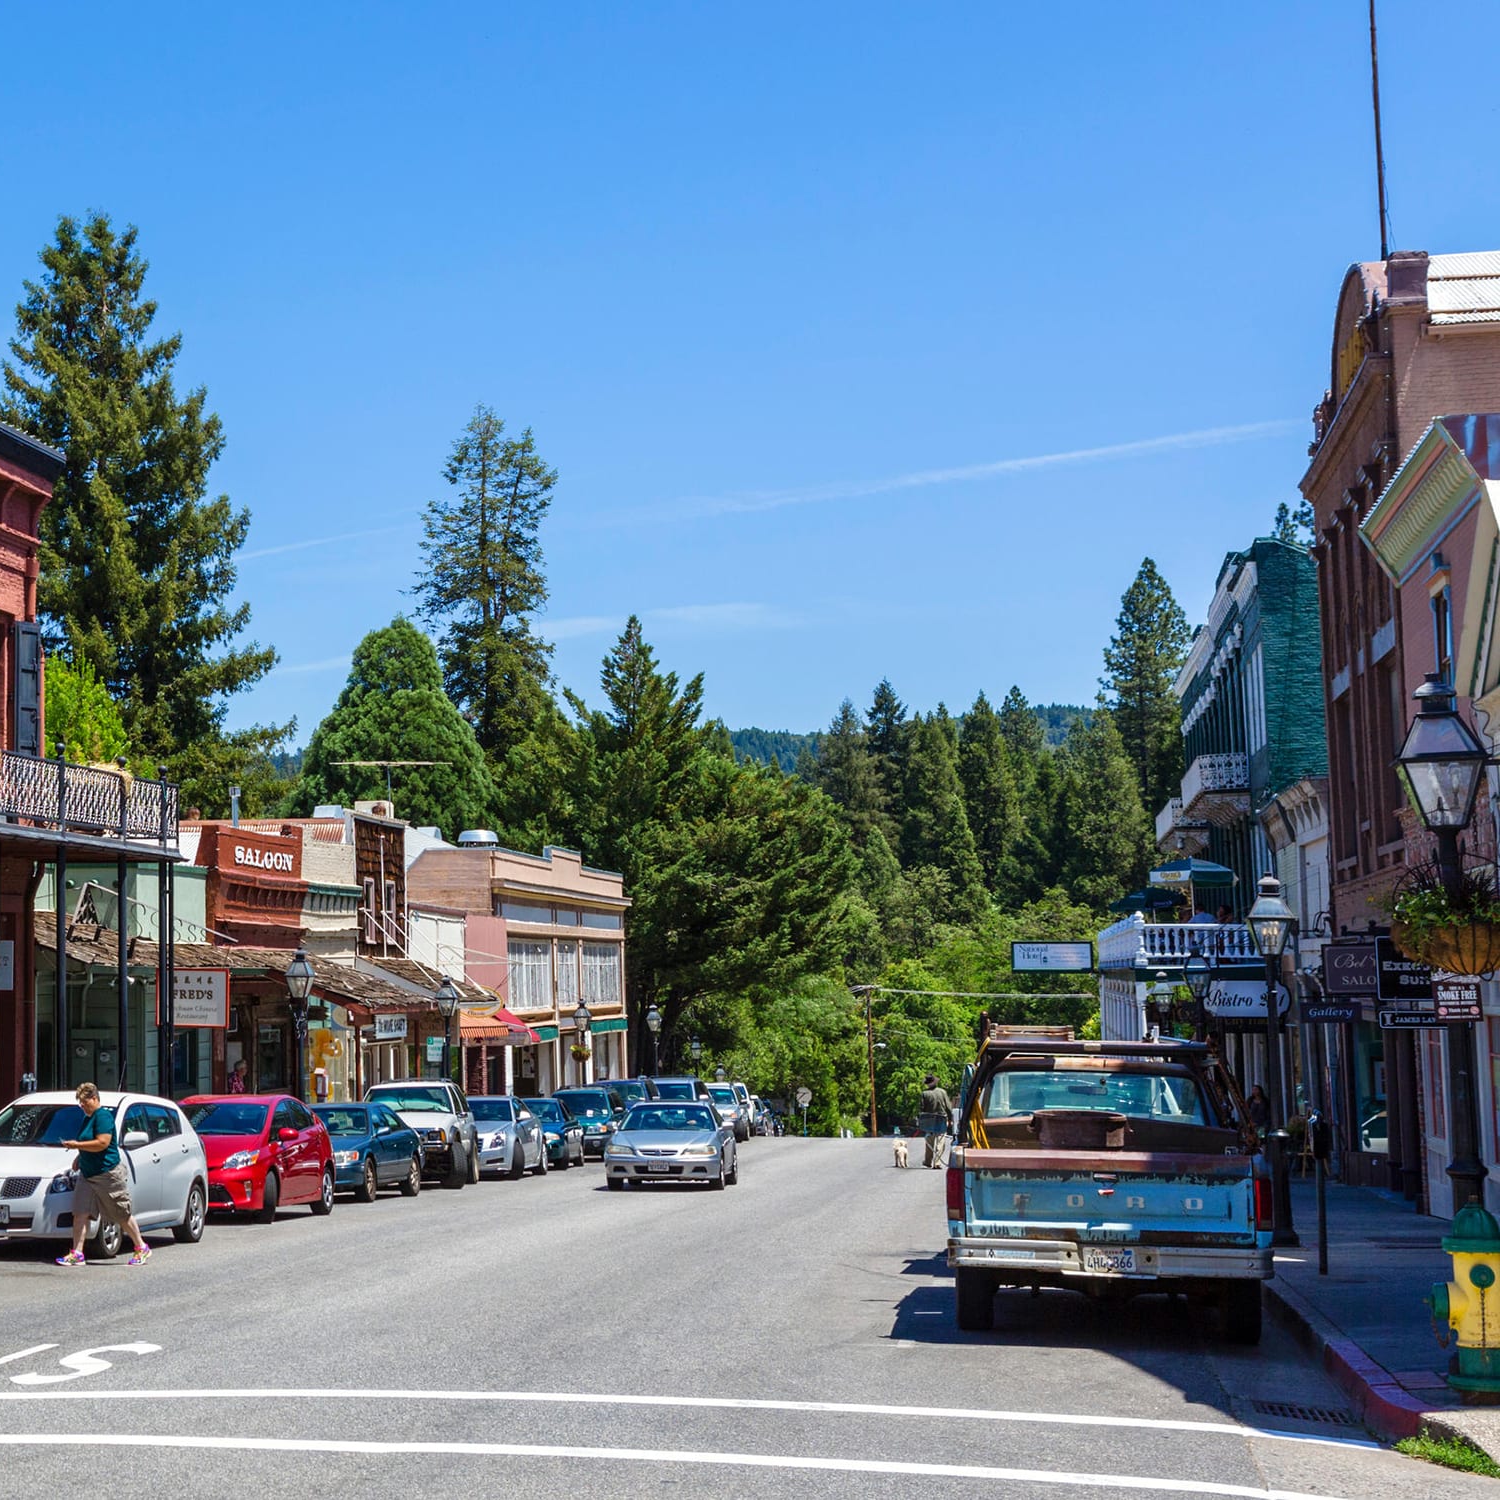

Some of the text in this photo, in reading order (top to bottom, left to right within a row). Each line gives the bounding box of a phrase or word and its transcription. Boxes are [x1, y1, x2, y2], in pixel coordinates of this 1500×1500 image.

[234, 845, 294, 871] SALOON
[173, 989, 213, 1000] FRED'S
[1206, 989, 1285, 1008] Bistro 21
[1437, 990, 1477, 1000] SMOKE FREE
[1308, 1006, 1353, 1017] Gallery
[1012, 1192, 1204, 1211] FORD
